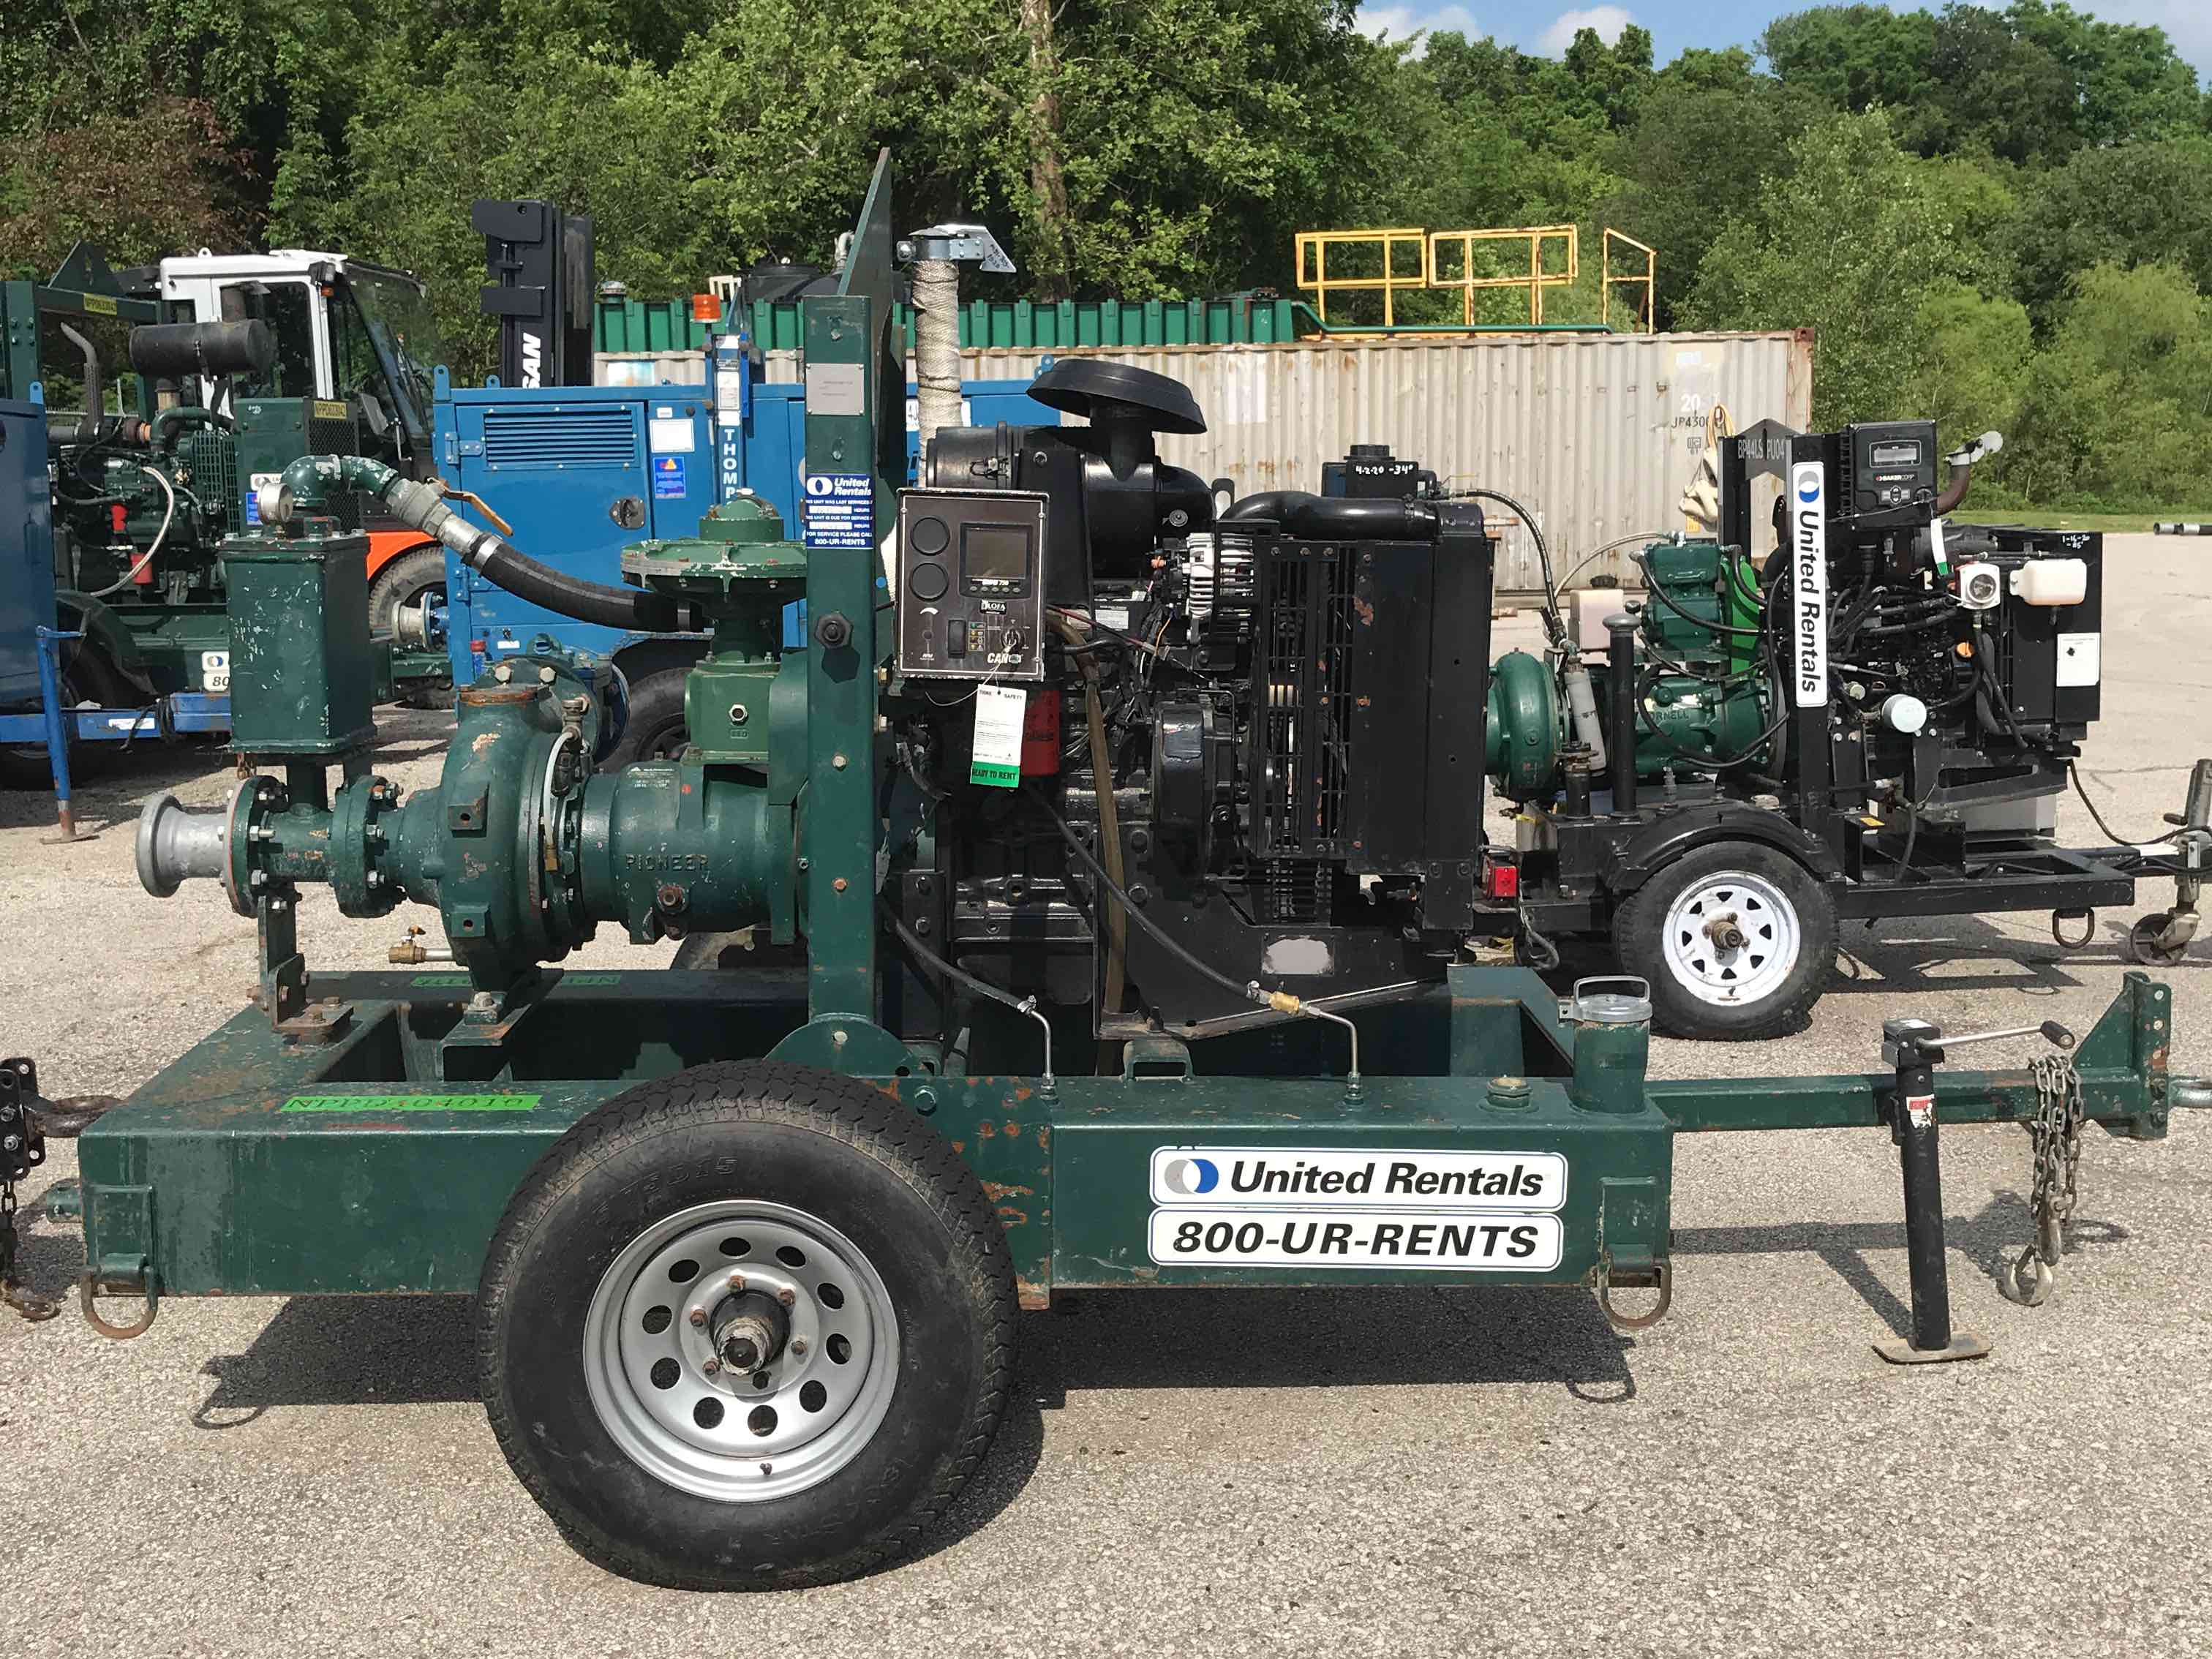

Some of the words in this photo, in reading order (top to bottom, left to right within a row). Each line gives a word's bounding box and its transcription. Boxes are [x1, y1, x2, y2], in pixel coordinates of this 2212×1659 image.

[1681, 394, 1701, 412] 20
[722, 429, 738, 505] THOMP
[834, 478, 870, 486] United
[834, 486, 872, 495] Rentals
[1799, 511, 1820, 594] United
[1801, 602, 1821, 693] Rentals
[990, 770, 997, 779] TO
[998, 770, 1017, 780] RENT
[625, 854, 709, 872] PIONEER
[1230, 1161, 1376, 1195] United
[1385, 1162, 1545, 1196] Rentals
[1173, 1221, 1540, 1258] 800-UR-RENTS
